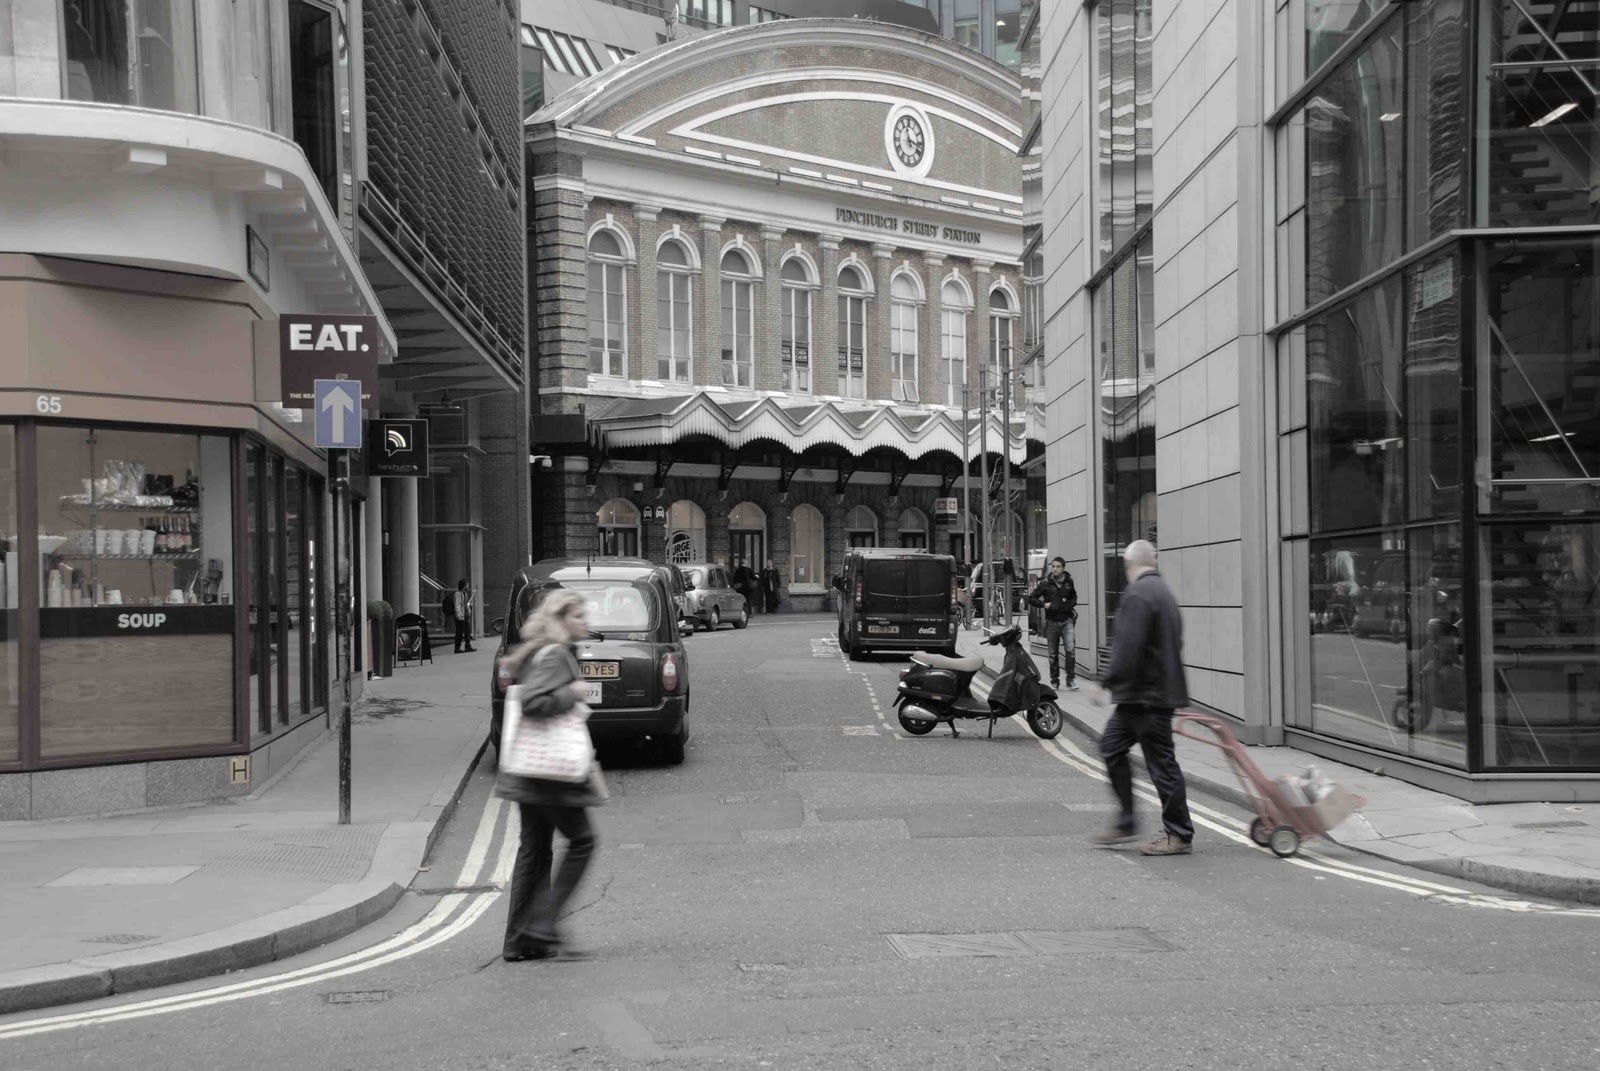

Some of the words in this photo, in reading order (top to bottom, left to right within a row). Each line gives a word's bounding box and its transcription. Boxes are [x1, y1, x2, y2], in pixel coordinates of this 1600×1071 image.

[836, 207, 897, 231] FENCHURCH
[903, 219, 939, 238] STREET
[943, 226, 981, 244] STATION
[289, 323, 370, 352] EAT.
[37, 395, 62, 414] 65
[118, 613, 166, 628] SOUP
[594, 665, 615, 675] YES
